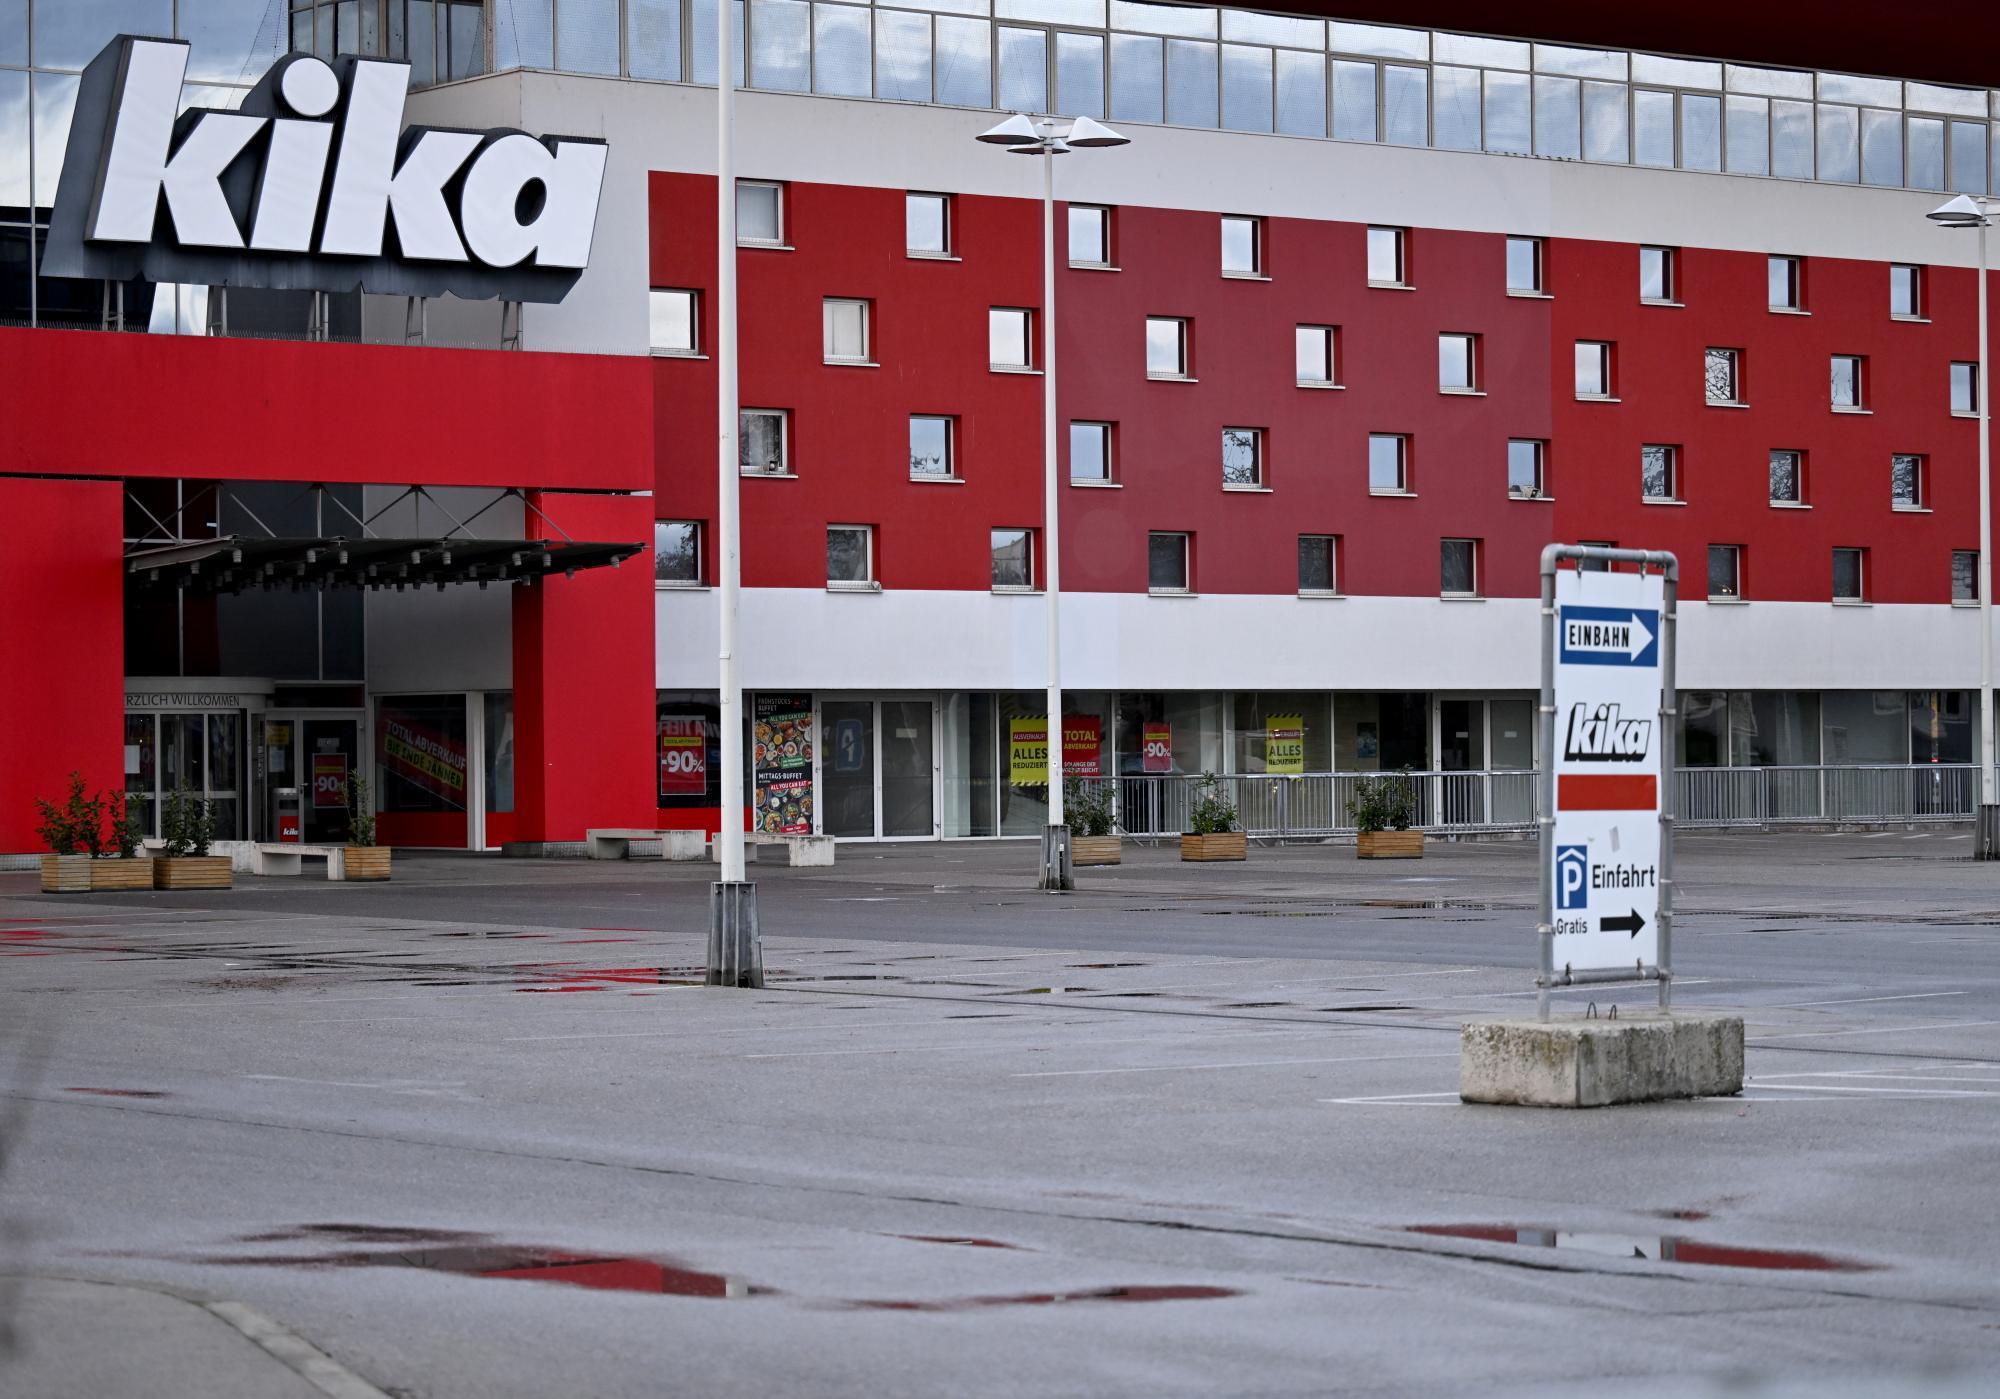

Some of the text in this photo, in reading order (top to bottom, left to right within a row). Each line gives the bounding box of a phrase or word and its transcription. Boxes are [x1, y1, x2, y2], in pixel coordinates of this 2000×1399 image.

[72, 35, 610, 280] kika
[1569, 625, 1630, 648] EINBAHN
[126, 694, 240, 706] RZLICH WILLKOMMEN
[1064, 730, 1097, 741] TOTAL
[1563, 702, 1652, 762] kika
[384, 719, 466, 770] TOTAL ABVERKAUF
[1013, 748, 1048, 760] ALLES
[1143, 742, 1171, 758] -90%
[1268, 744, 1301, 756] ALLES
[401, 746, 426, 768] ENDE
[661, 751, 704, 773] -90%
[758, 772, 802, 780] MITTAGS-BUFFET
[1562, 861, 1655, 907] P Einfahrt
[1556, 917, 1588, 935] Gratis
